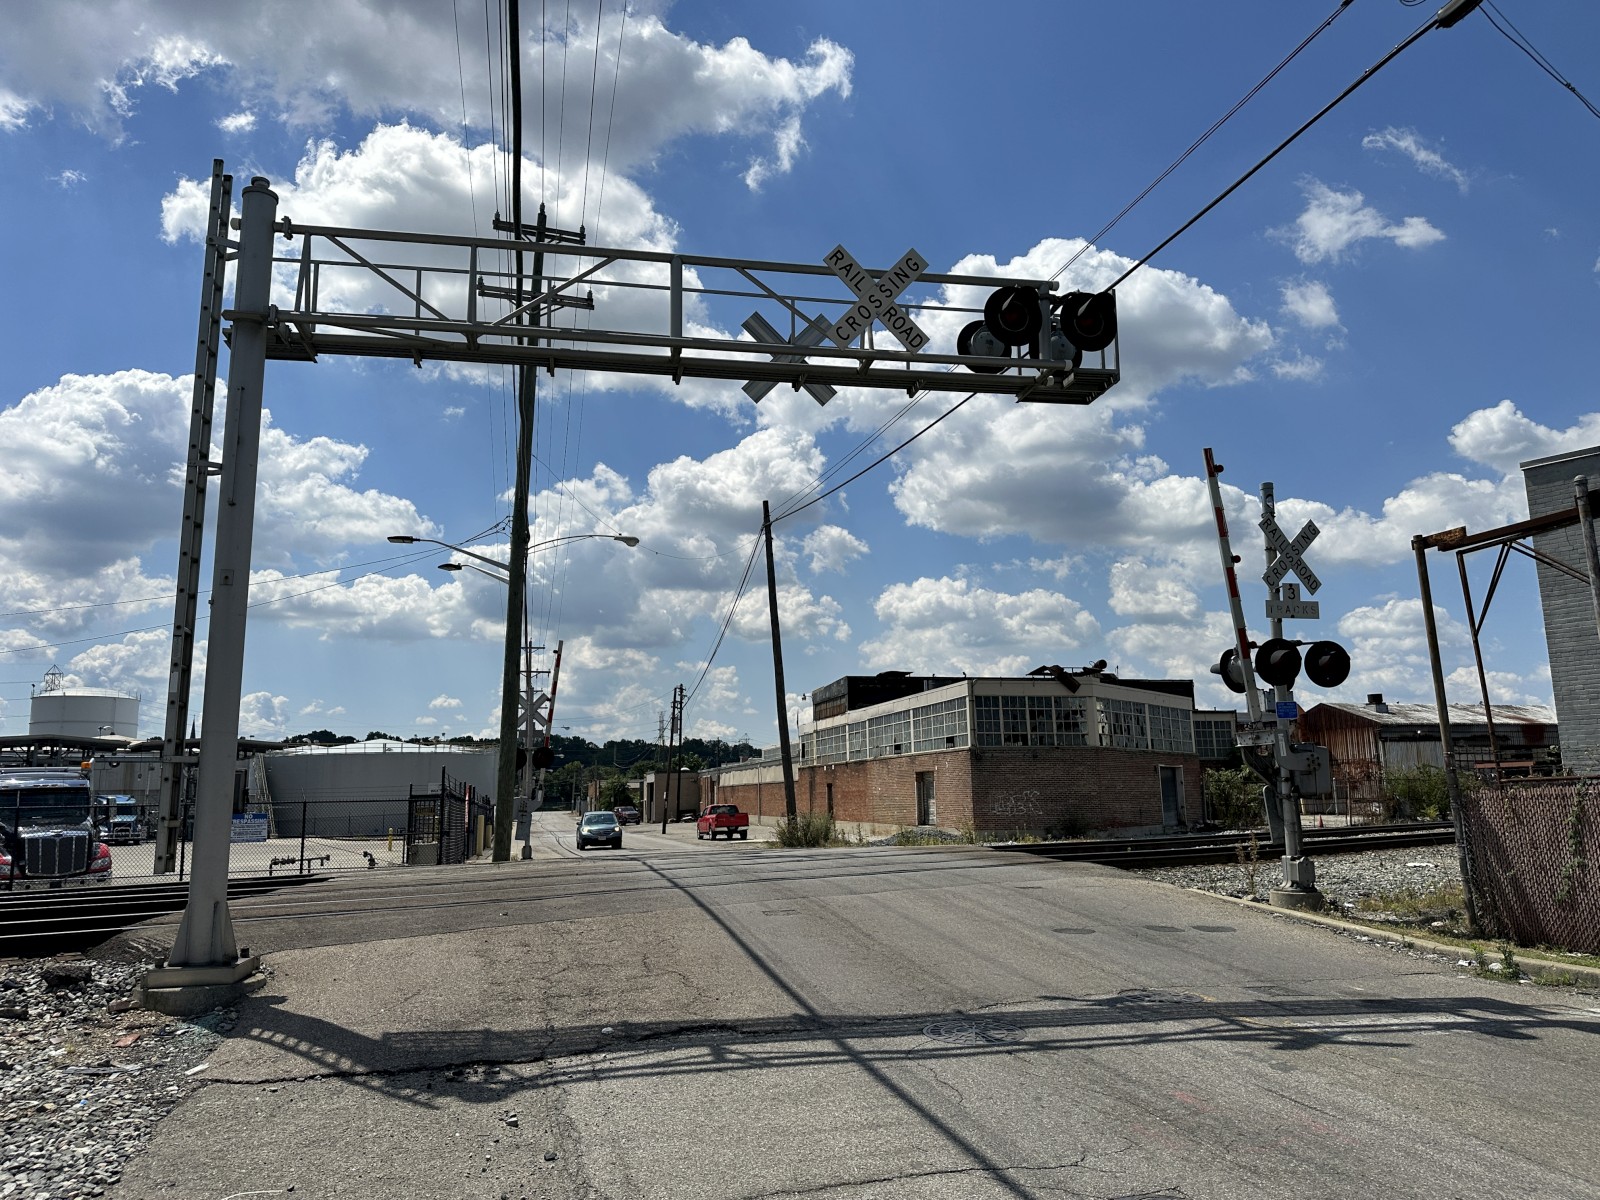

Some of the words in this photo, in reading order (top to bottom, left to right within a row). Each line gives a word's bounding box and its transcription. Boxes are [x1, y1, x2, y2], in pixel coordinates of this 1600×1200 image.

[829, 249, 866, 292] RAIL
[882, 306, 923, 348] ROAD
[836, 258, 920, 340] CROSSING
[1262, 518, 1286, 552] RAIL
[1293, 558, 1318, 591] ROAD
[1266, 524, 1317, 586] CROSSING
[1269, 605, 1317, 615] TRACKS
[1287, 587, 1296, 600] 3
